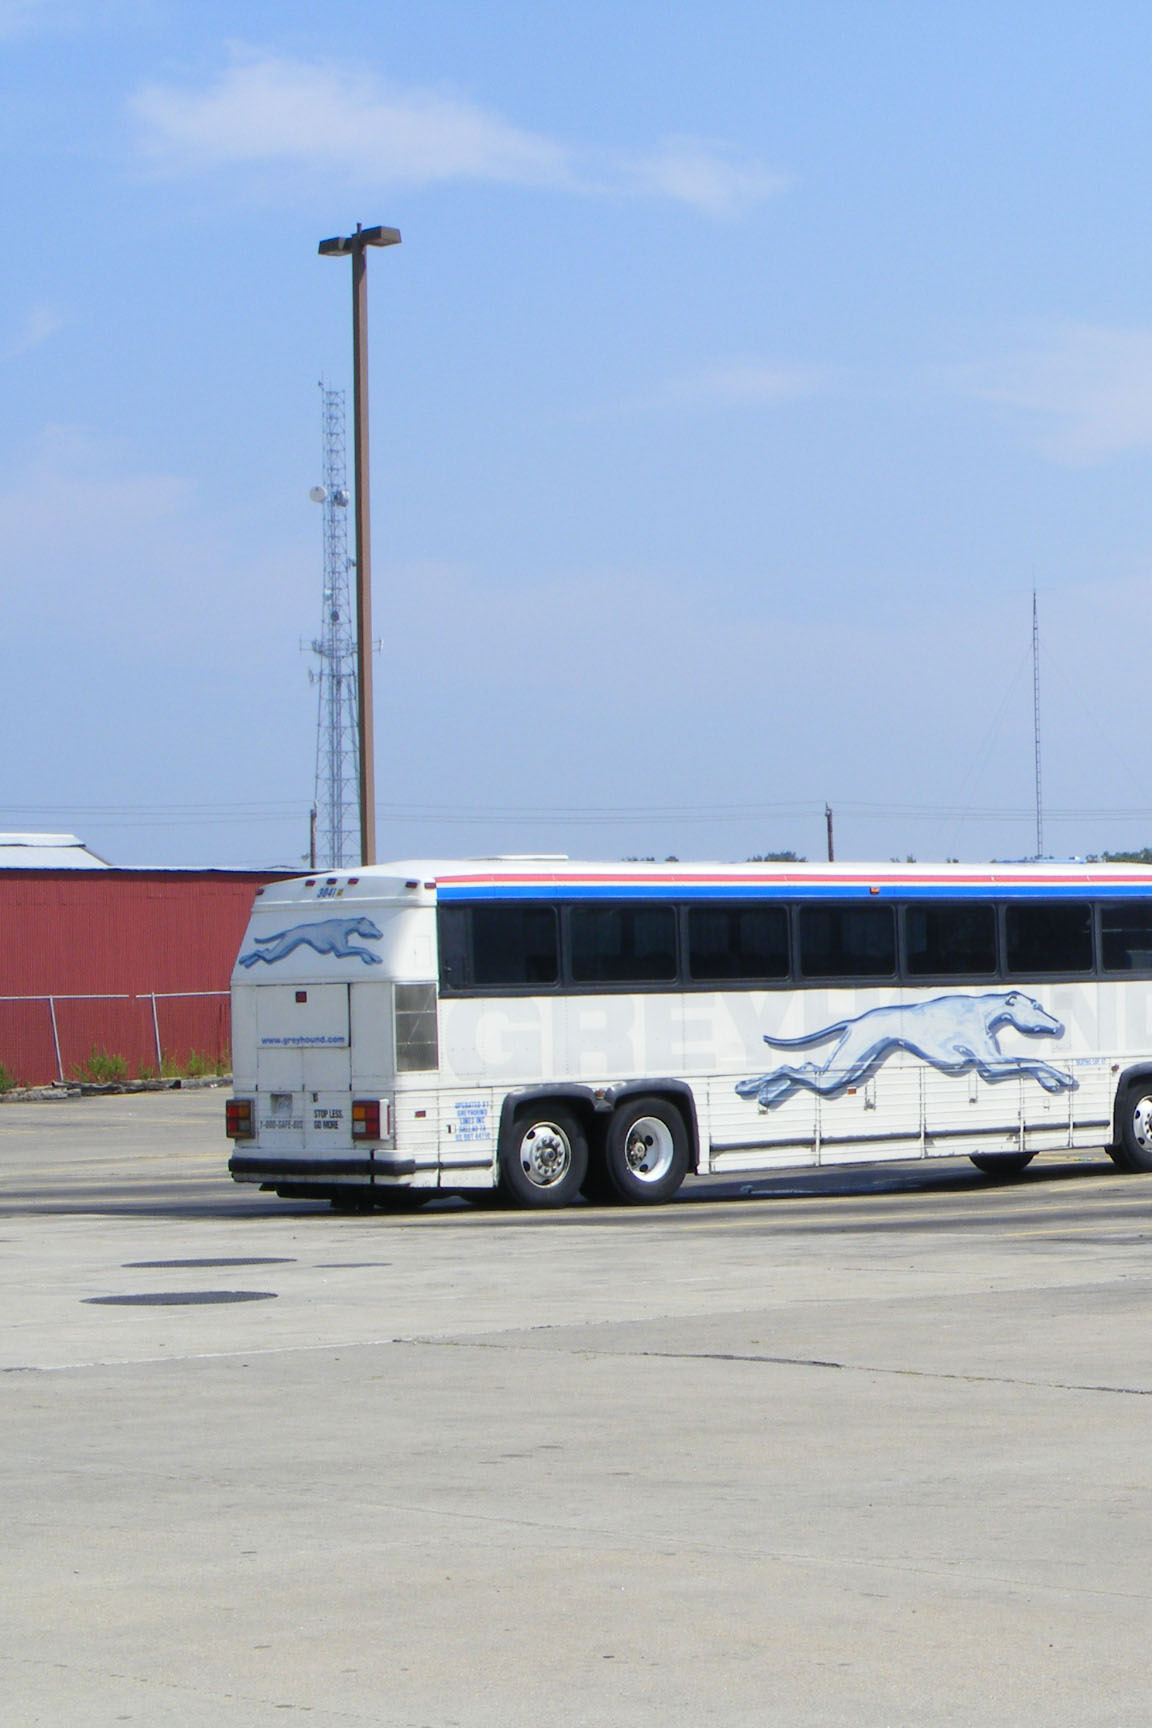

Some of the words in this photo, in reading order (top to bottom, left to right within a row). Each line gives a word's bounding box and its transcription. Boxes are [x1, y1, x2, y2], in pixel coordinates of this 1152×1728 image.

[261, 1036, 345, 1045] www.greyhound.com
[314, 1109, 328, 1118] STOP
[314, 1120, 322, 1129] GO
